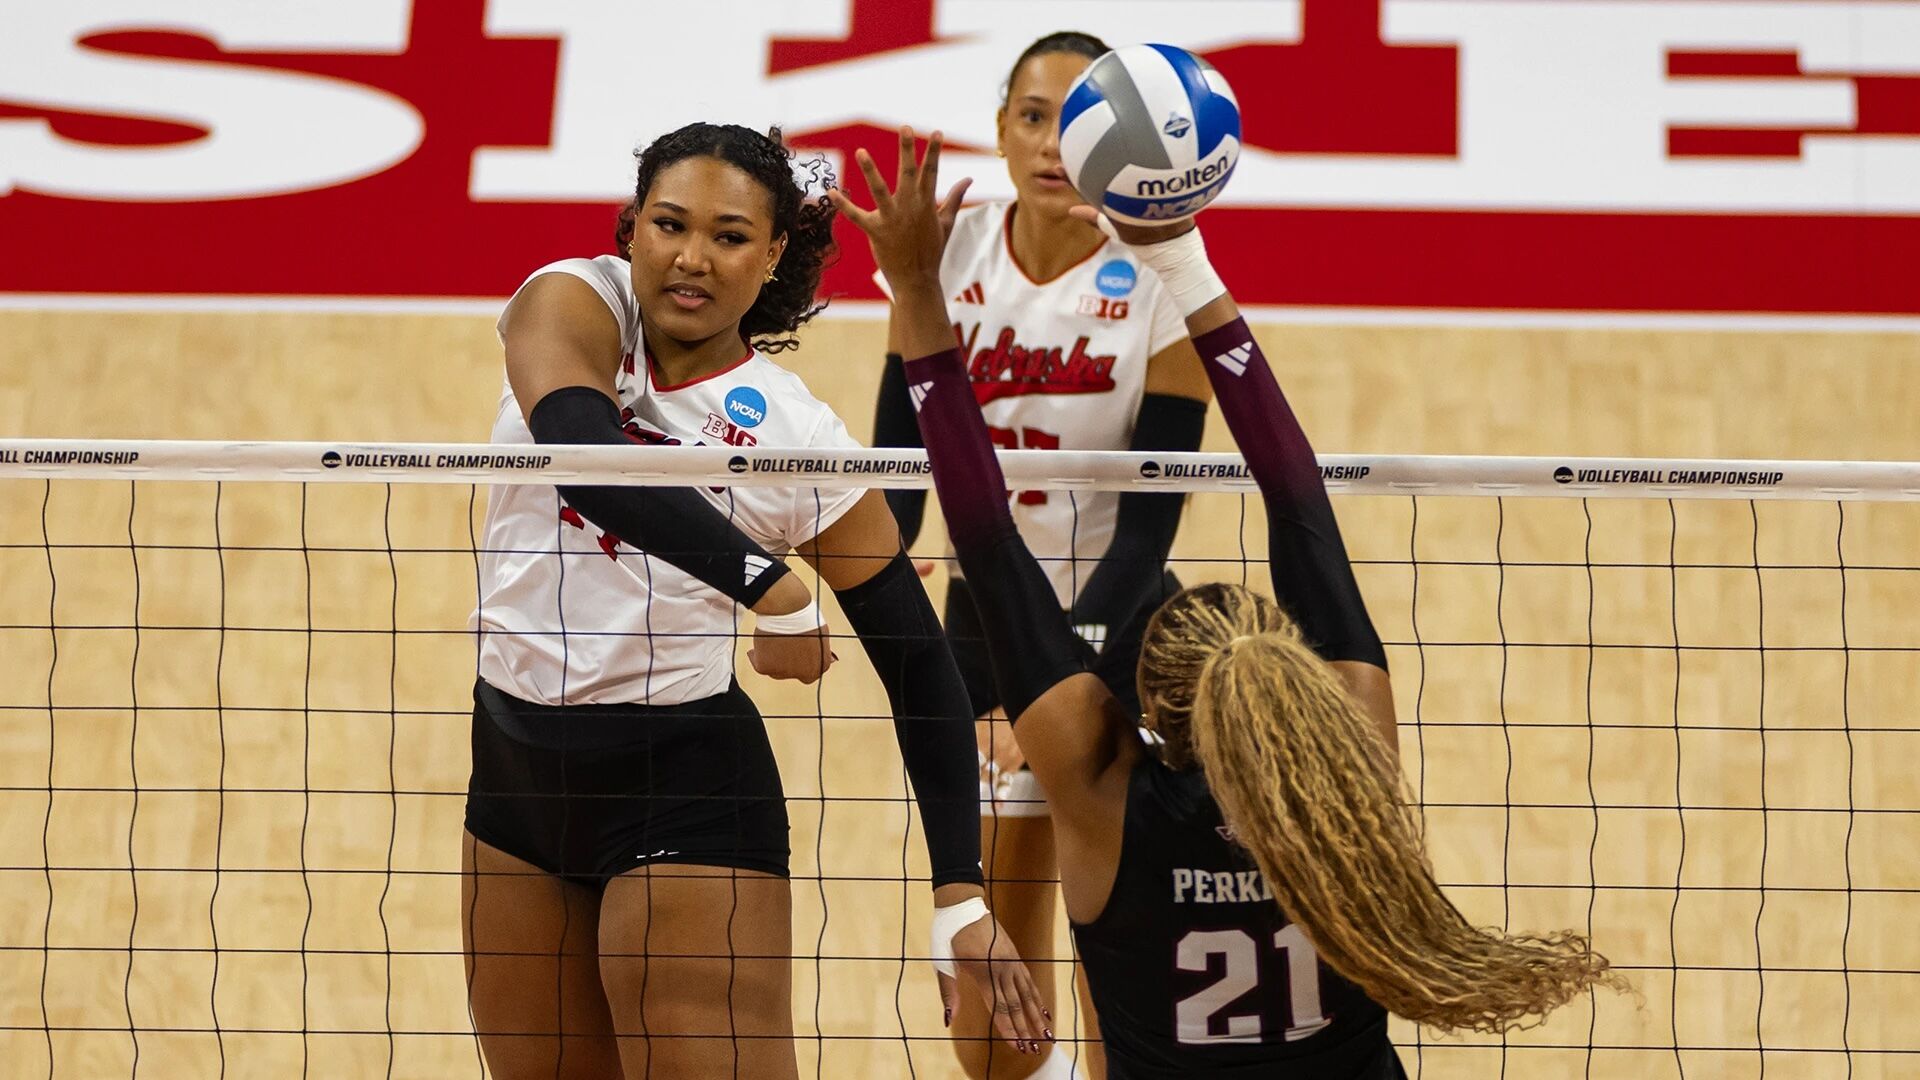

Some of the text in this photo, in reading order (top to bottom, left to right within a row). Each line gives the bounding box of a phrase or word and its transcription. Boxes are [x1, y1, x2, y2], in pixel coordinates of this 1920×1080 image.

[1137, 154, 1230, 197] molten
[730, 400, 763, 422] NCAA
[24, 450, 139, 465] CHAMPIONSHIP
[346, 454, 432, 468] VOLLEYBALL
[436, 455, 552, 470] CHAMPIONSHIP
[752, 458, 838, 473] VOLLEYBALL
[1164, 463, 1250, 478] VOLLEYBALL
[1578, 469, 1663, 483] VOLLEYBALL
[1668, 470, 1784, 485] CHAMPIONSHIP
[1176, 923, 1332, 1043] 21
